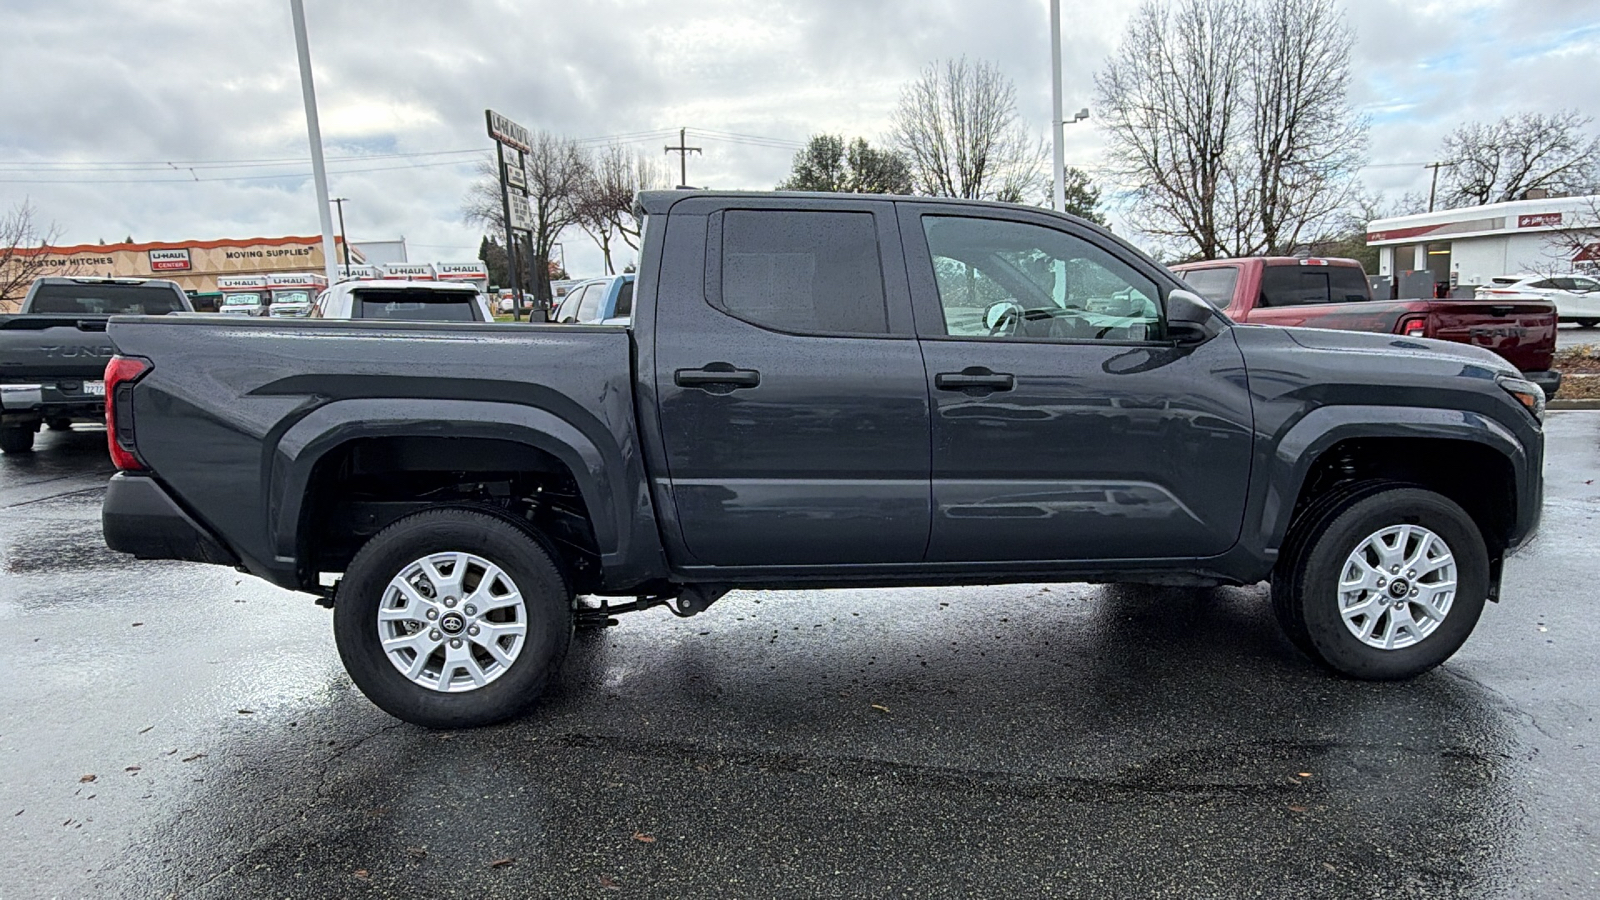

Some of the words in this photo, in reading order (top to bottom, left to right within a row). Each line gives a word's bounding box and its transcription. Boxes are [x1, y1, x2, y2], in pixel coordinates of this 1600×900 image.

[226, 251, 263, 259] MOVING
[266, 249, 309, 257] SUPPLIES
[23, 259, 66, 267] CUSTOM
[69, 257, 114, 266] HITCHES
